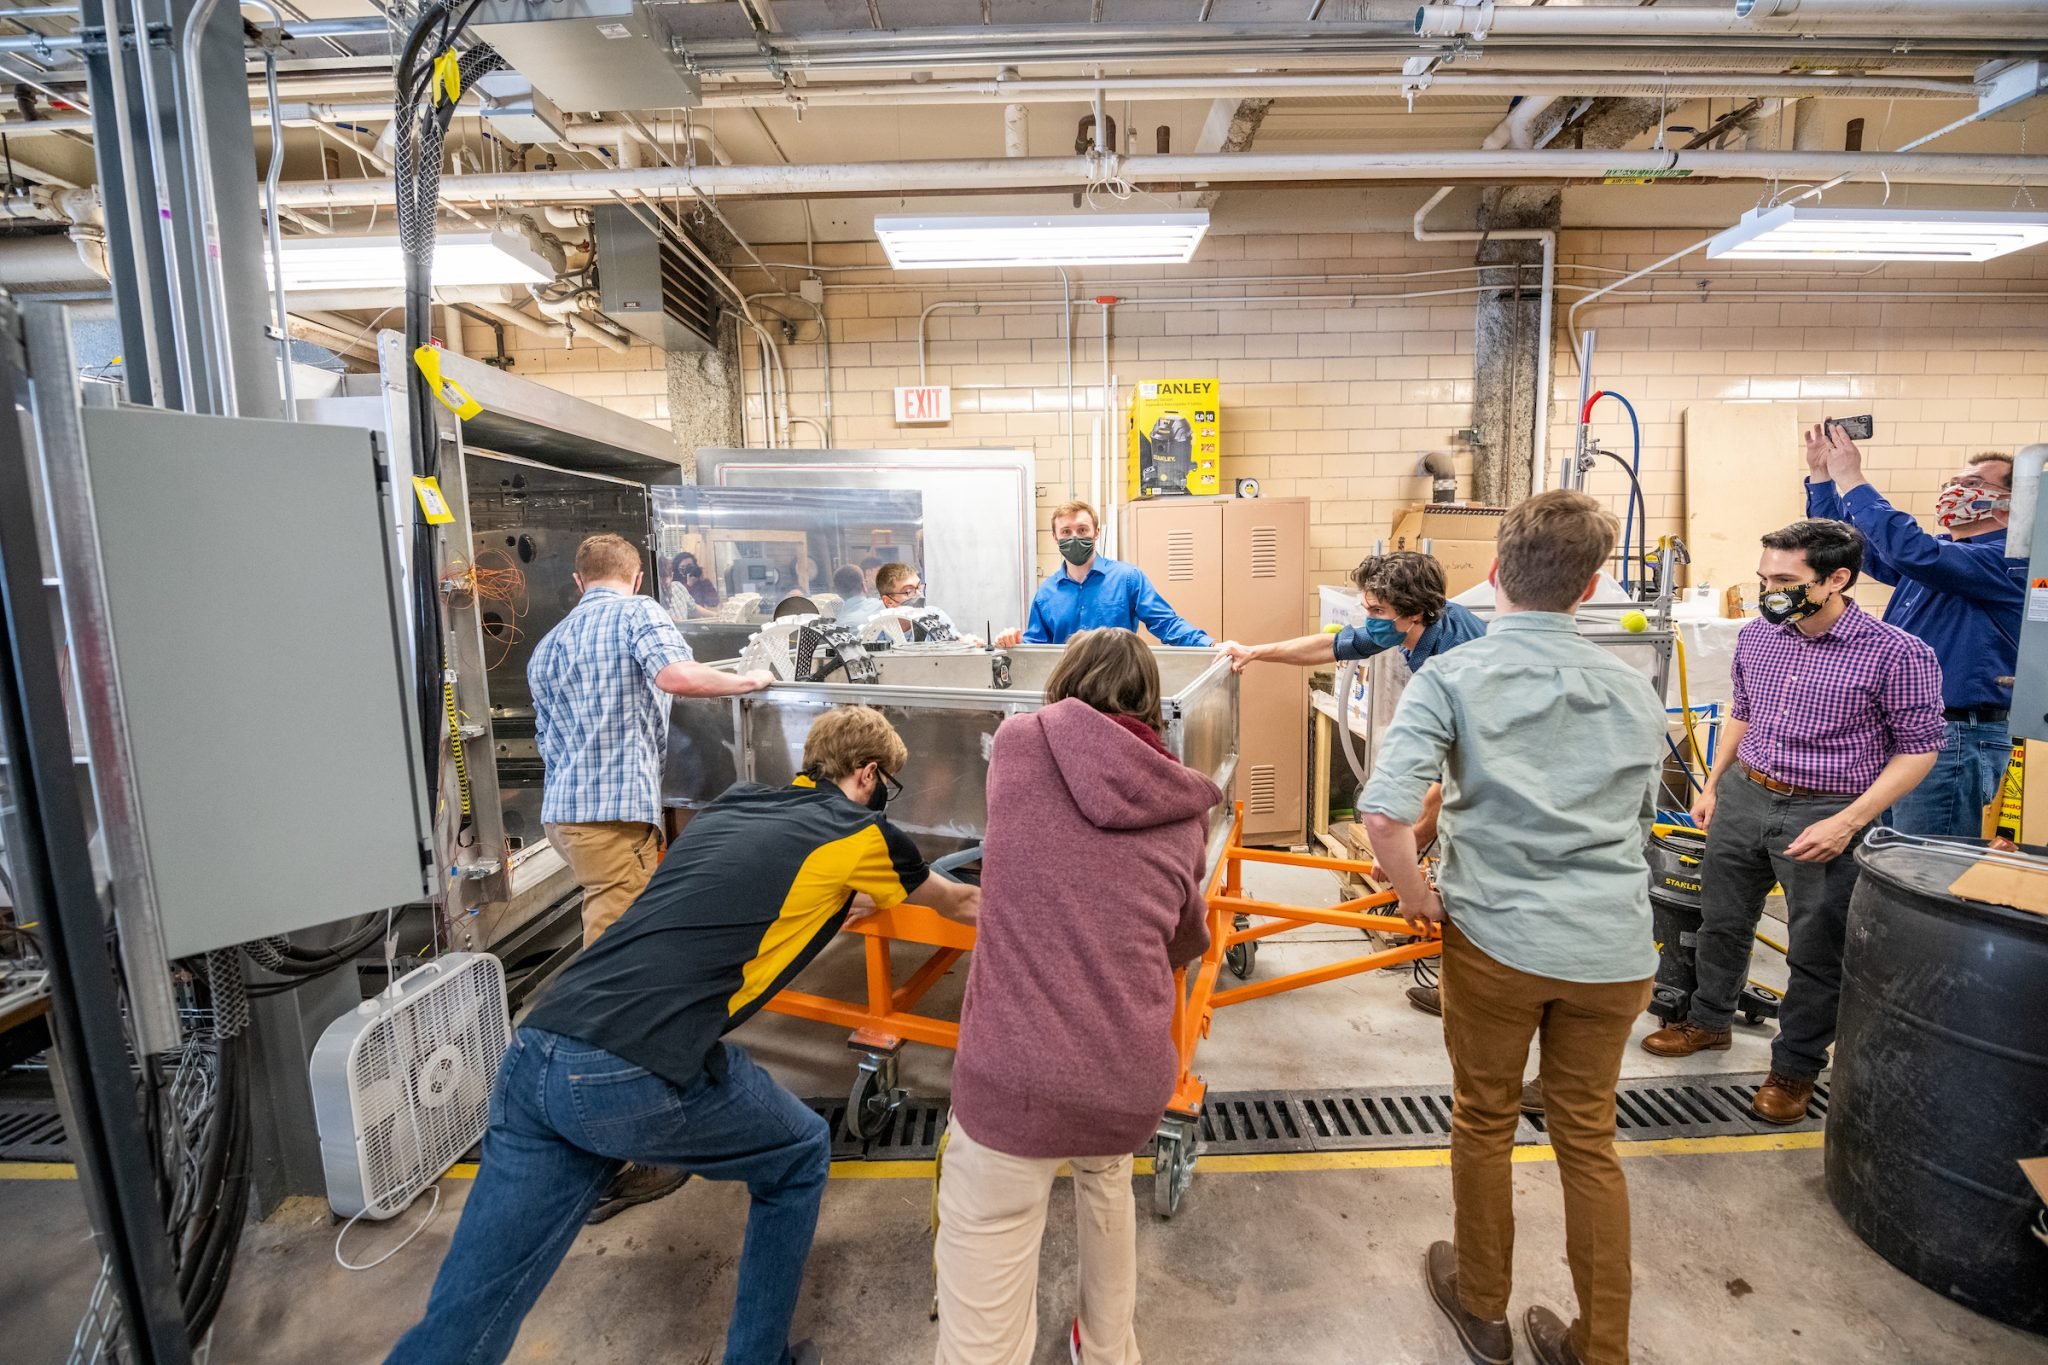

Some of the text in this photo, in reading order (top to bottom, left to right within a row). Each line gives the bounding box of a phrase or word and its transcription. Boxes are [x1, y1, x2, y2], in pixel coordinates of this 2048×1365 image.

[1156, 383, 1211, 394] TANLEY
[904, 389, 942, 418] EXIT
[1665, 878, 1702, 891] STANLEY
